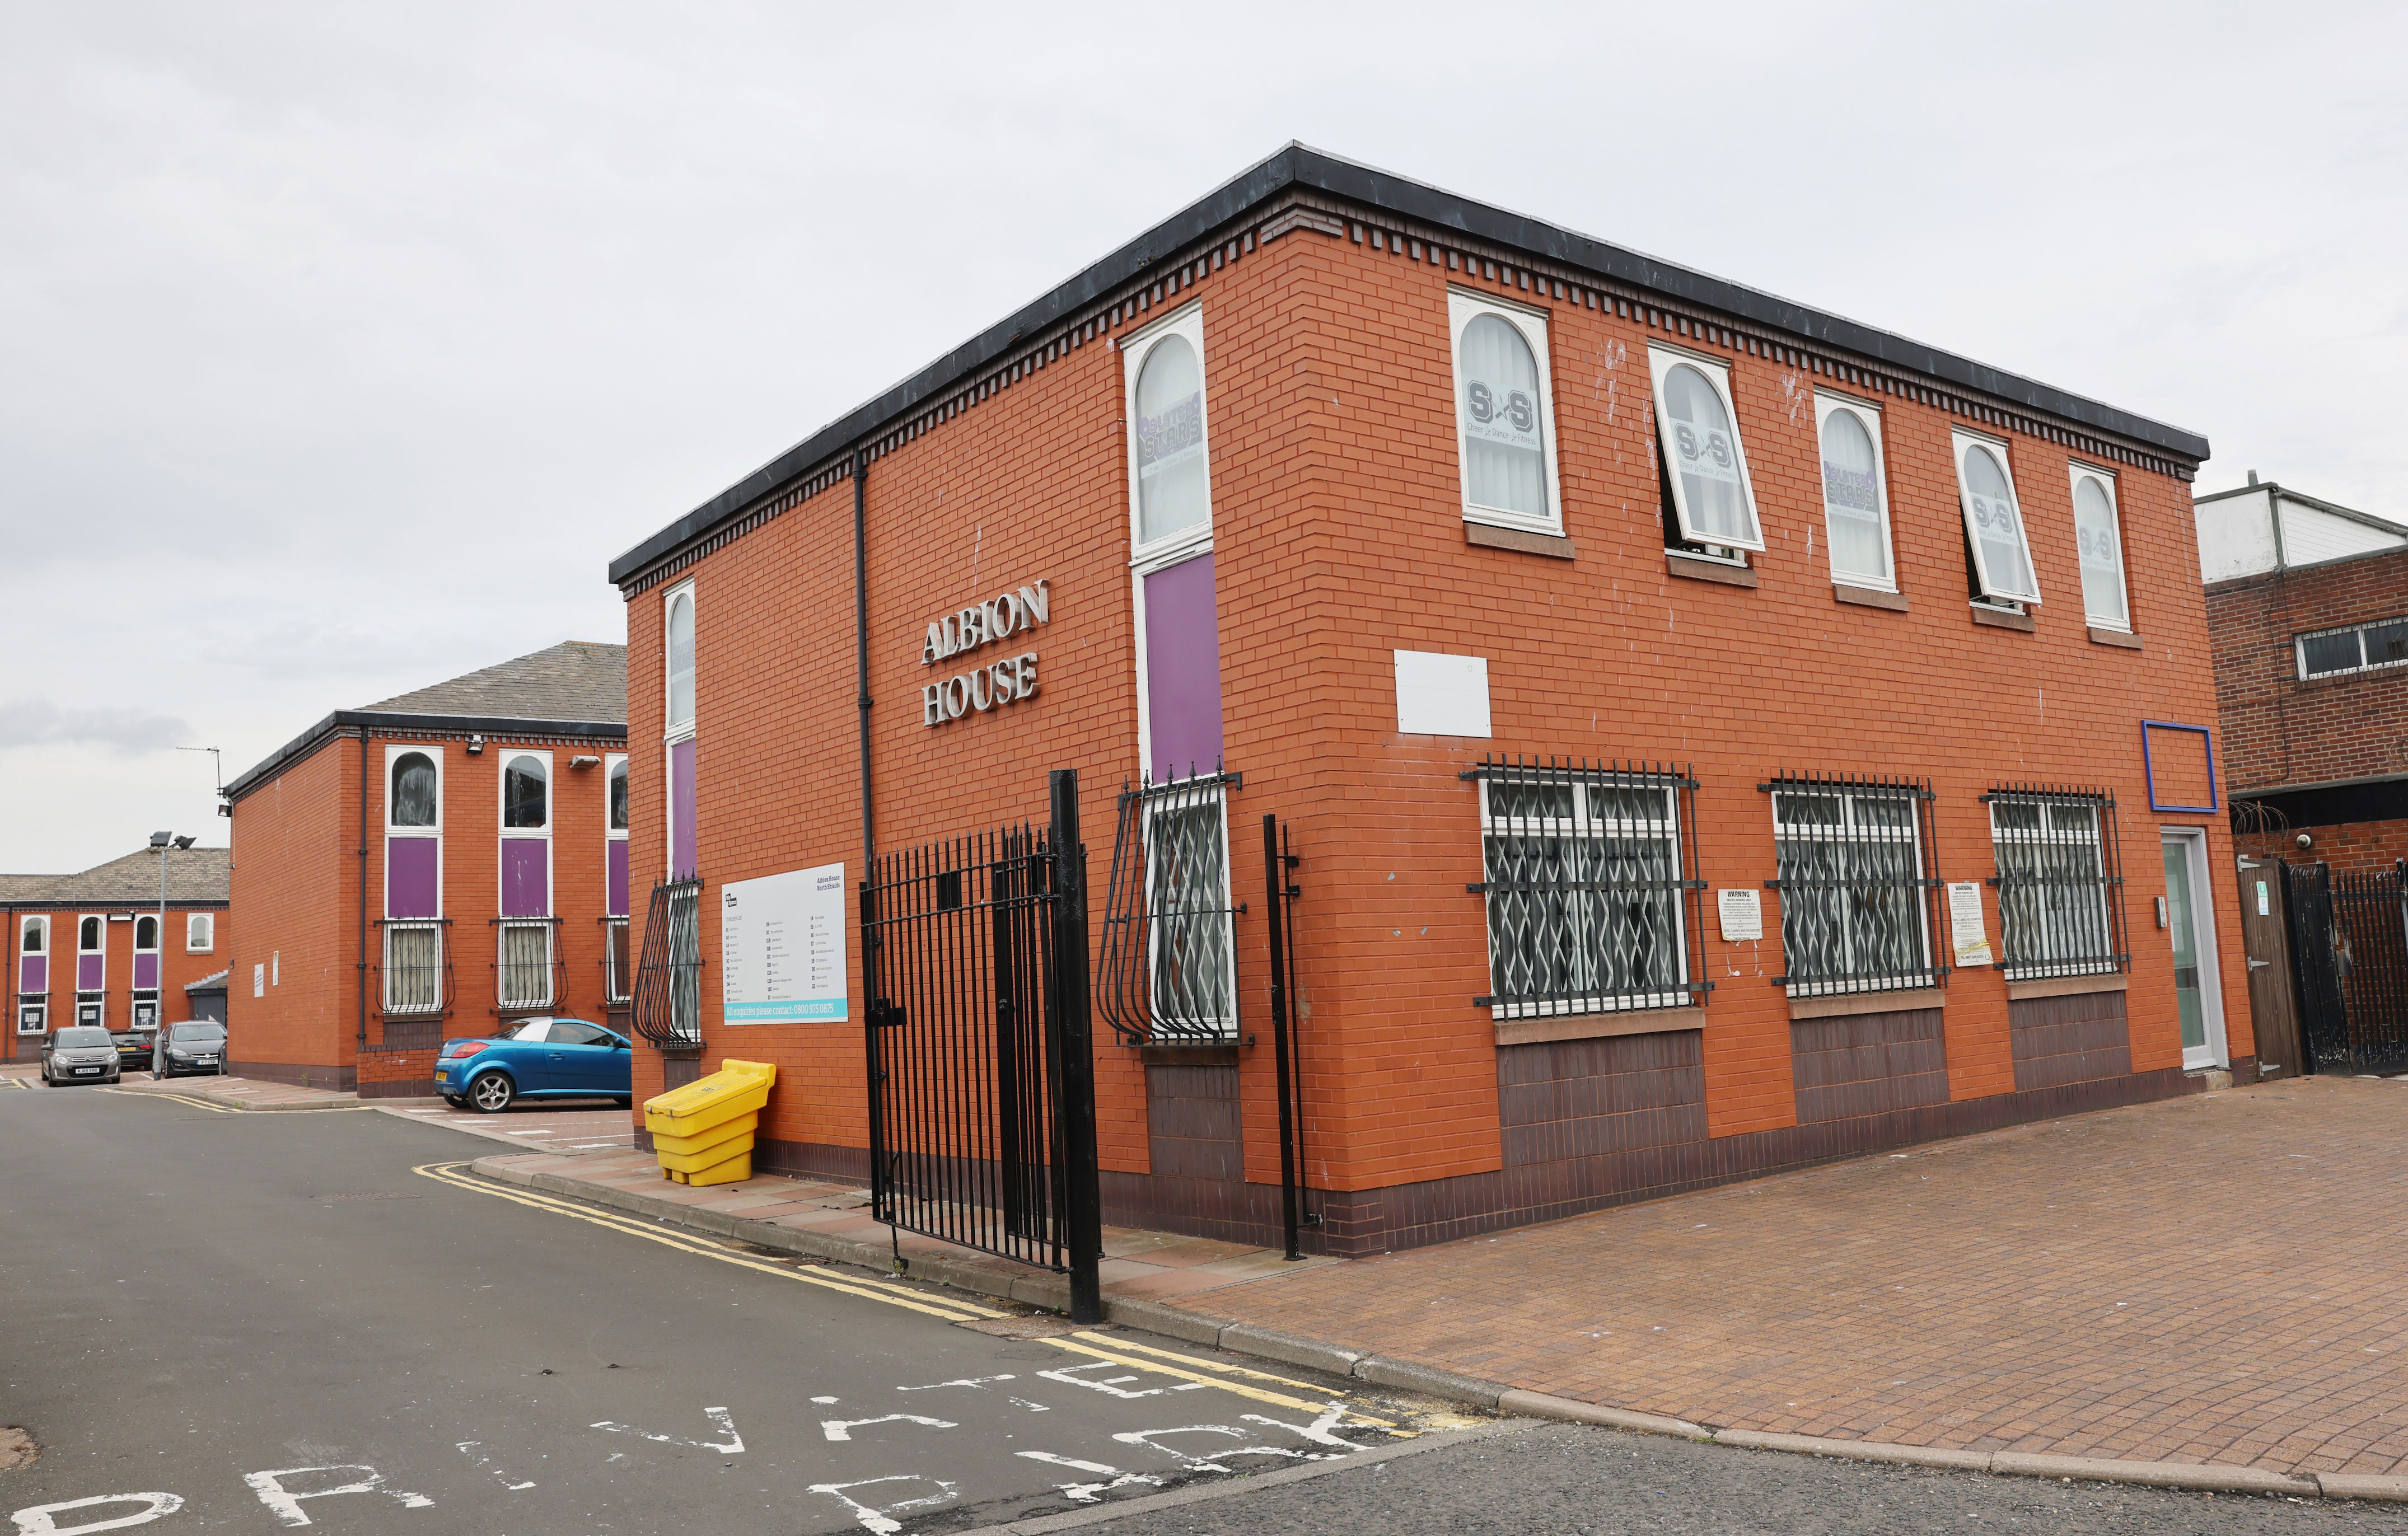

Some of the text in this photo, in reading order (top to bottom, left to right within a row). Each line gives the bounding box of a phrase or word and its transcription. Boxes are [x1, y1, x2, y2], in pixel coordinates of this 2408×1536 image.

[1149, 402, 1193, 433] SLATER
[1144, 415, 1199, 458] STARS
[1467, 423, 1536, 445] Cheer Dance Fitness
[1148, 465, 1160, 474] Cheer
[1680, 460, 1736, 479] Cheer Dance Fitness
[1831, 467, 1867, 486] SLATER
[1827, 480, 1873, 506] STARS
[920, 579, 1050, 666] ALBION
[921, 652, 1040, 727] HOUSE
[733, 1006, 755, 1017] enquiries
[756, 1006, 772, 1017] please
[773, 1005, 793, 1015] contact:
[794, 1004, 808, 1014] 0800
[809, 1004, 819, 1014] 975
[820, 1003, 834, 1013] 0875
